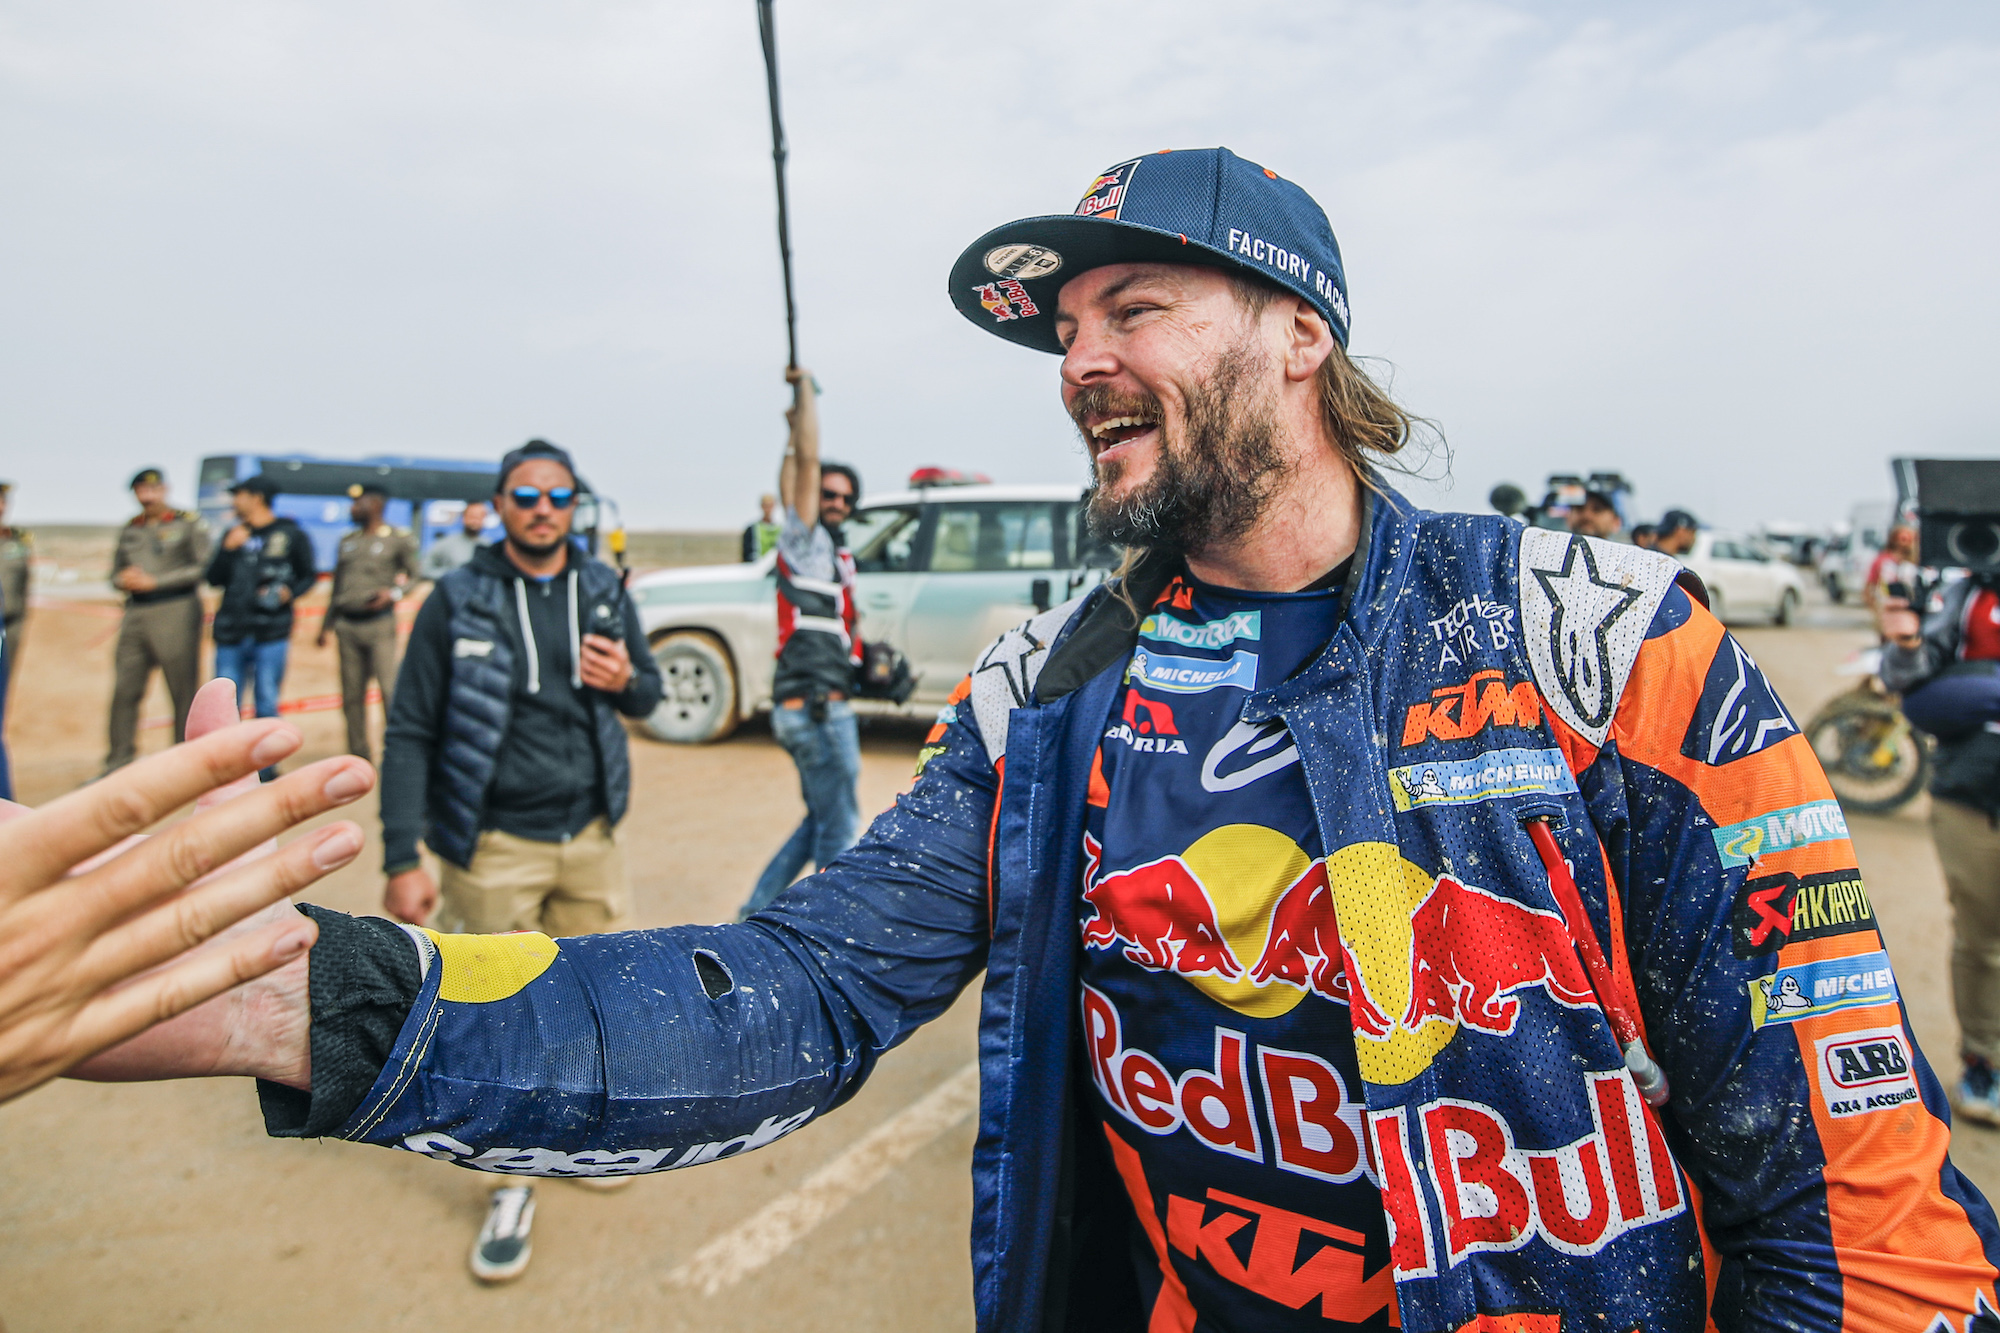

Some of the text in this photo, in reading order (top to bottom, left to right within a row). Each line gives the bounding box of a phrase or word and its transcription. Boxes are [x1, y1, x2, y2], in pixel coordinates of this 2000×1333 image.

[1083, 185, 1124, 216] Bull
[1229, 228, 1312, 283] FACTORY
[996, 279, 1027, 301] Bull
[1009, 296, 1041, 318] Red
[1157, 615, 1254, 647] MOTOREX
[1428, 594, 1482, 640] TECH
[1438, 624, 1483, 672] AIR
[1150, 662, 1242, 684] MICHELIN
[1402, 669, 1541, 747] KTM
[1450, 764, 1563, 792] MICHELIN
[1081, 977, 1264, 1164] Red
[1834, 1041, 1908, 1083] ARB
[1830, 1098, 1861, 1114] 4X4
[1417, 1064, 1688, 1271] Bull
